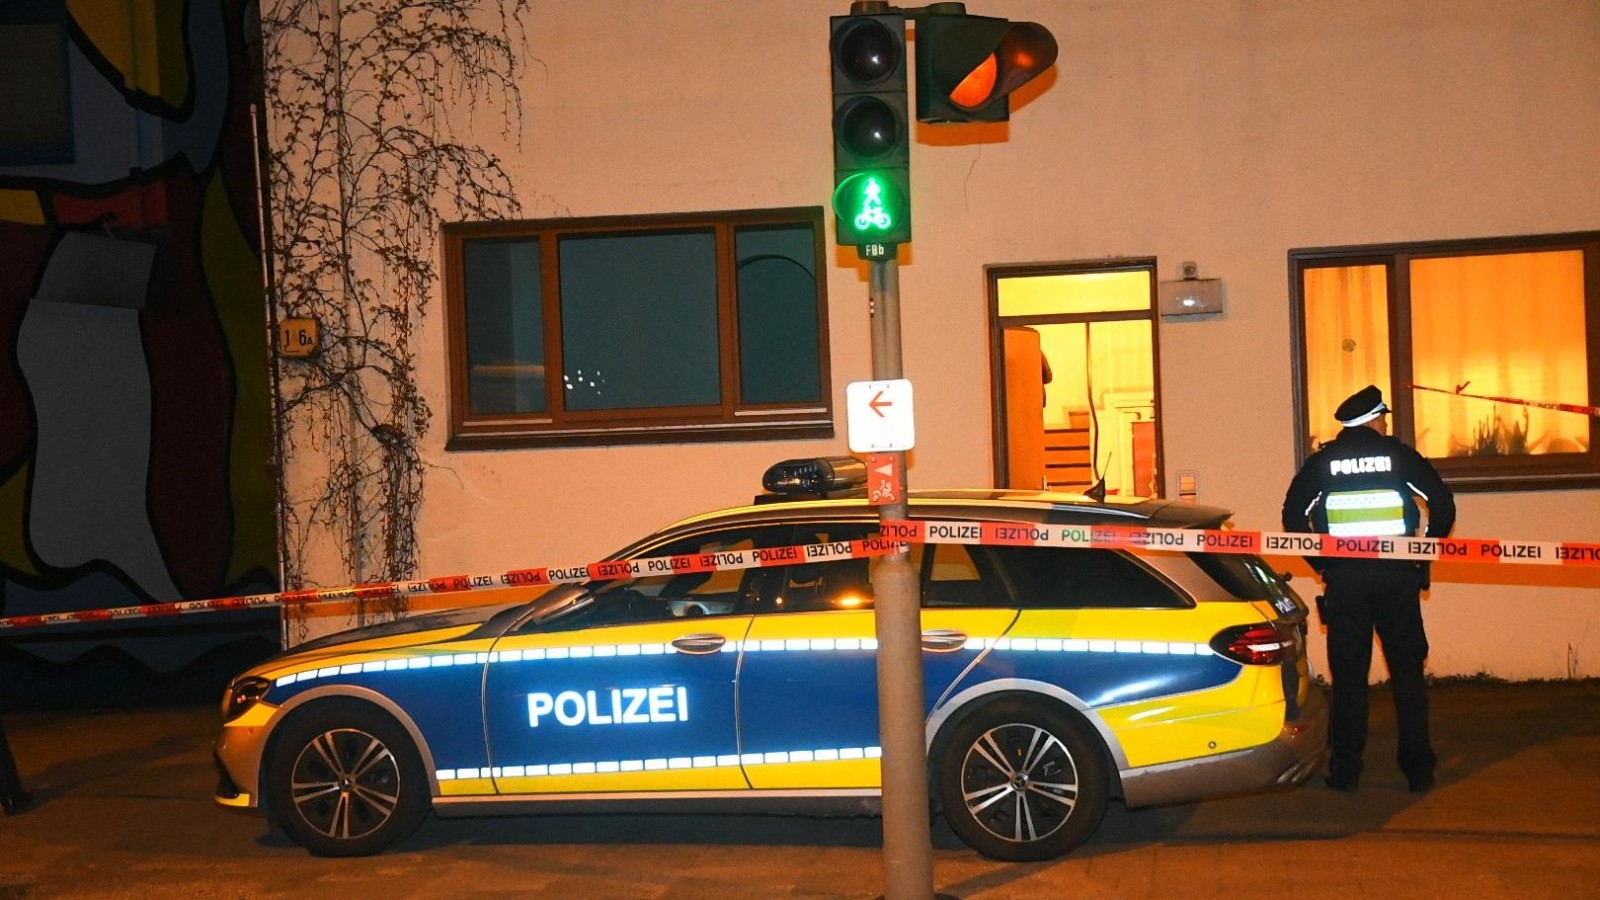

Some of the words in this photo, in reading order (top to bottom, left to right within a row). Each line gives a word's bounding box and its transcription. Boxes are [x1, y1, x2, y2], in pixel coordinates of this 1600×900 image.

[1330, 456, 1391, 476] POLIZEI
[930, 526, 982, 539] POLIZEI
[995, 527, 1049, 540] POLIZEI
[1061, 529, 1115, 542] POLIZEI
[1196, 534, 1253, 548] POLIZEI
[1266, 537, 1323, 550] POLIZEI
[1336, 539, 1394, 553] POLIZEI
[1408, 542, 1467, 555] POLIZEI
[1480, 544, 1541, 558] POLIZEI
[1556, 546, 1600, 560] OLIZEI
[453, 575, 493, 588] POLIZEI
[501, 571, 541, 584] POLIZEI
[548, 566, 590, 580] POLIZEI
[598, 562, 640, 576] POLIZEI
[648, 558, 691, 571] POLIZEI
[699, 552, 743, 567] POLIZEI
[752, 547, 797, 562] POLIZEI
[807, 542, 853, 557] POLIZEI
[527, 686, 689, 728] POLIZEI
